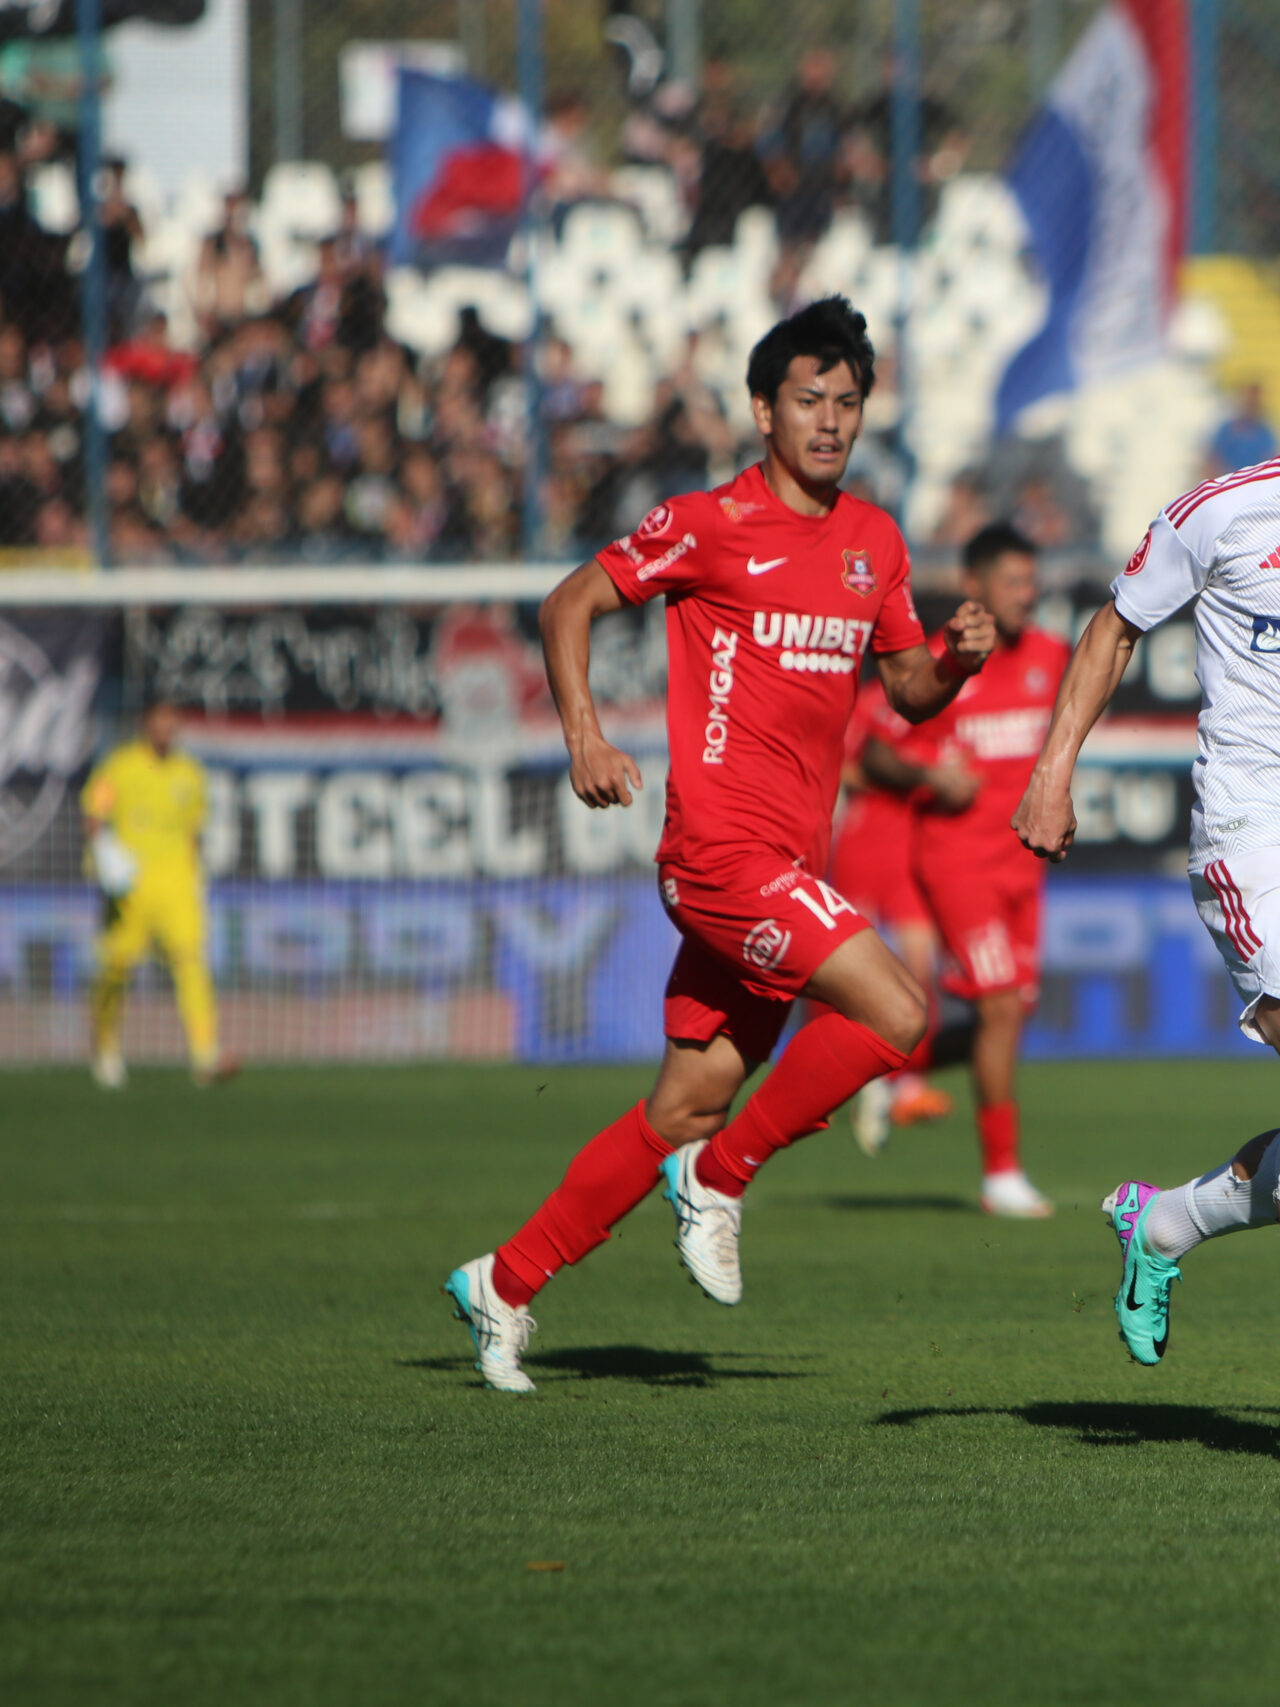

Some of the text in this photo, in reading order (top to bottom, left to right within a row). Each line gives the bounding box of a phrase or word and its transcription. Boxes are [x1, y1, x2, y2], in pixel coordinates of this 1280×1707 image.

[752, 610, 874, 656] UNIBET
[702, 626, 739, 765] ROMGAZ
[789, 879, 858, 931] 14
